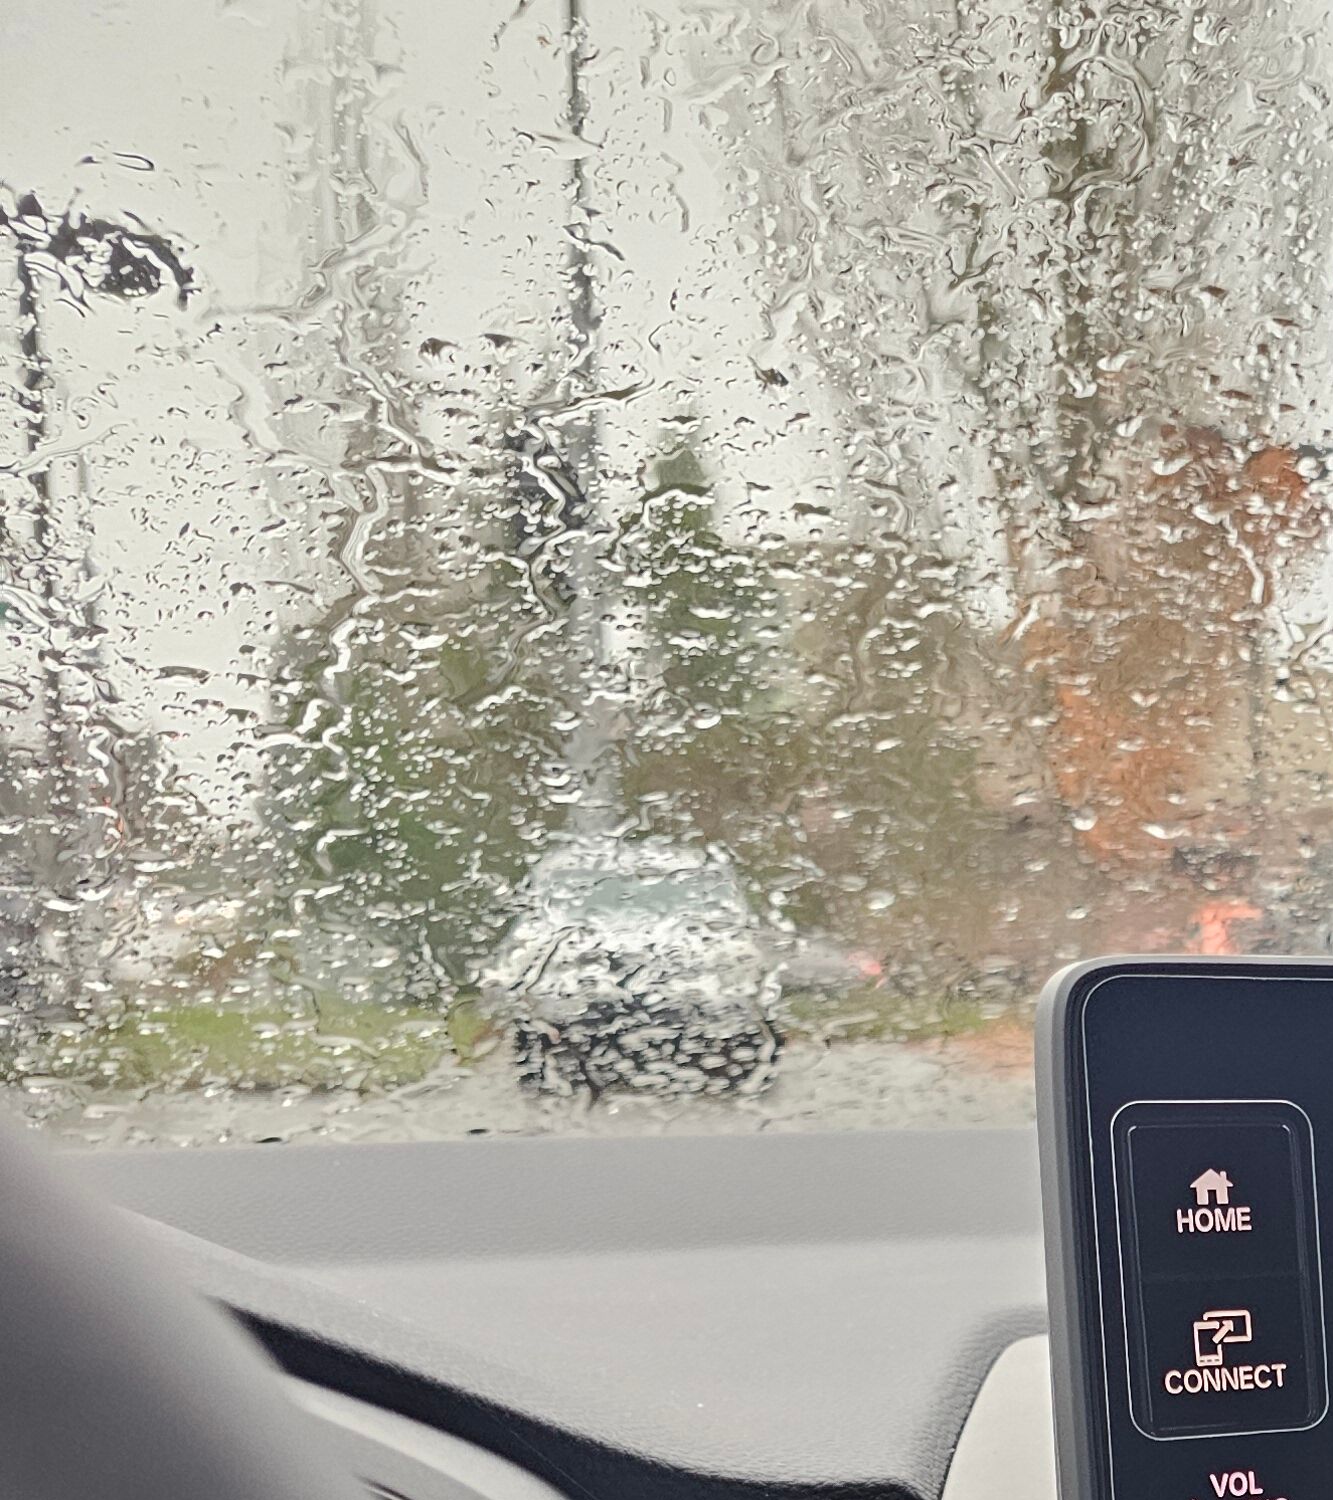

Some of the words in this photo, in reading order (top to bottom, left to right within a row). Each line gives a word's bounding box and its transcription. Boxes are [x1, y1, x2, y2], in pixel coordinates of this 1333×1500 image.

[1176, 1207, 1252, 1233] HOME
[1164, 1364, 1287, 1394] CONNECT
[1209, 1471, 1263, 1498] VOL
